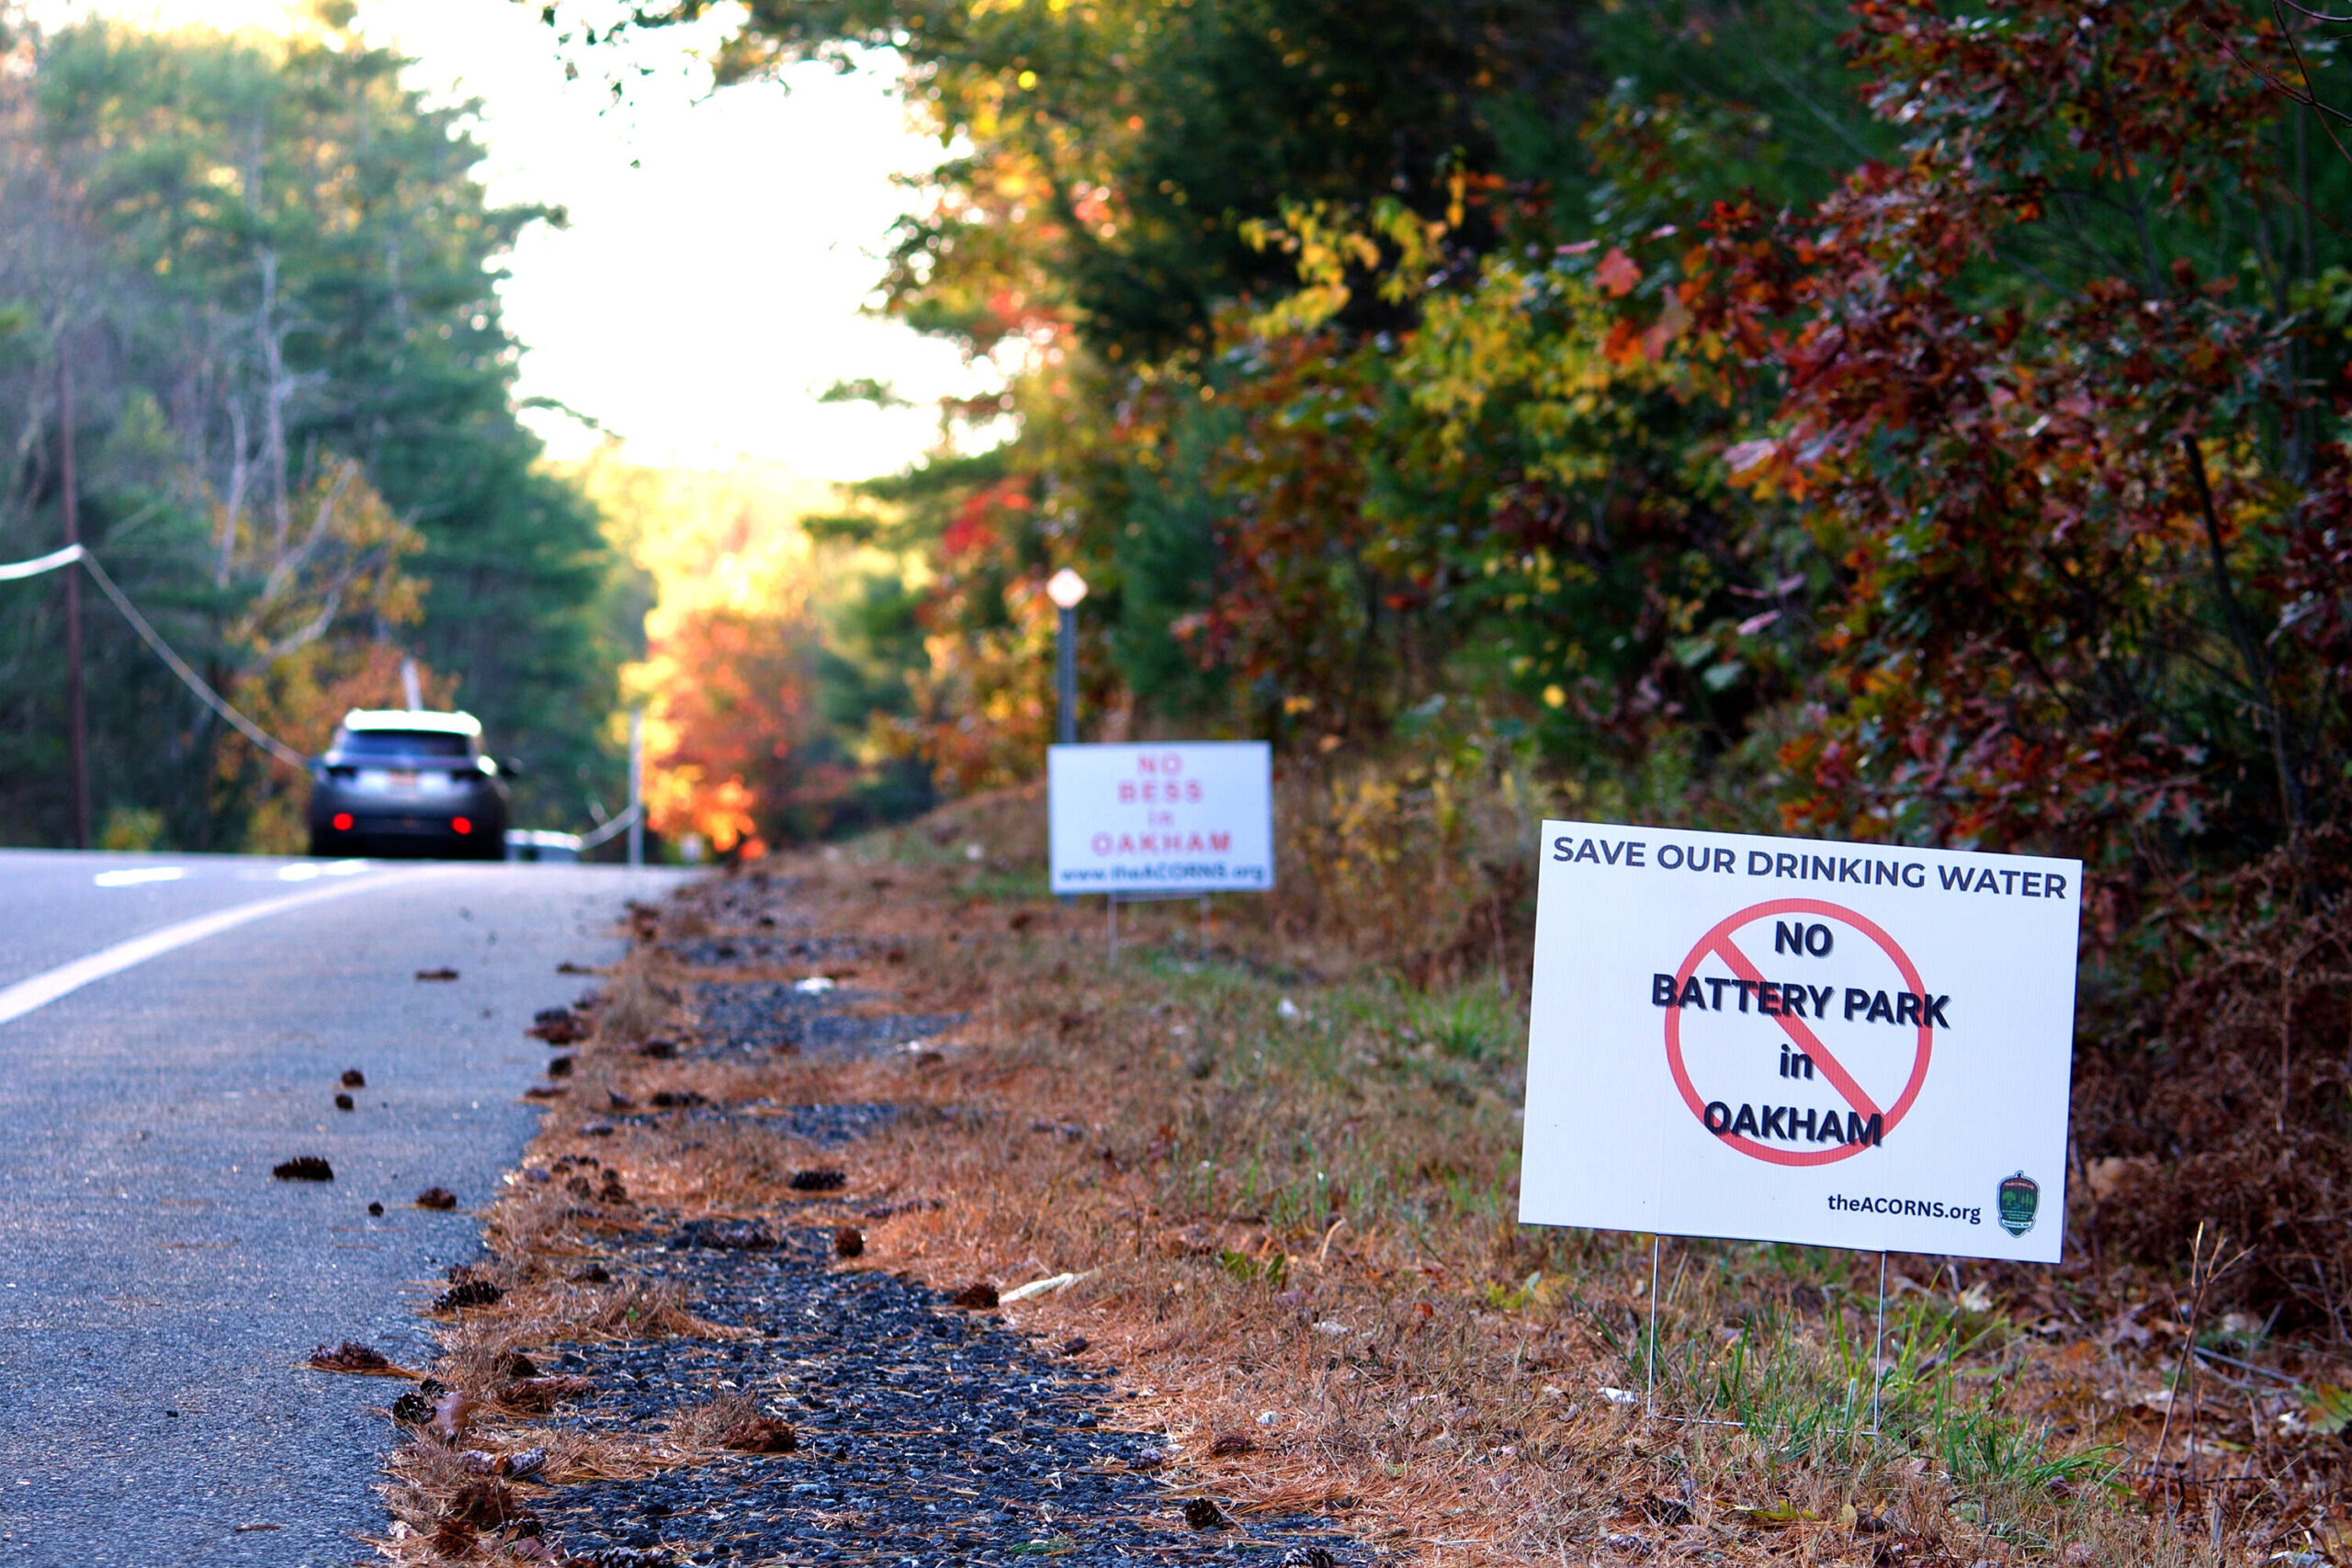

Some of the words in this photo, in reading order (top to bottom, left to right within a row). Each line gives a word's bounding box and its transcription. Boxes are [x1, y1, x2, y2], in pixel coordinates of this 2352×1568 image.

[1138, 753, 1183, 774] NO
[1118, 779, 1203, 805] BESS
[1091, 829, 1231, 857] OAKHAM
[1553, 837, 1646, 868] SAVE
[1657, 842, 1736, 874] OUR
[1747, 850, 1926, 888] DRINKING
[1938, 864, 2067, 899] WATER
[1774, 920, 1834, 957] NO
[1652, 973, 1833, 1021] BATTERY
[1843, 987, 1951, 1029] PARK
[1779, 1043, 1815, 1079] in
[1702, 1100, 1883, 1146] OAKHAM
[1827, 1194, 1982, 1224] theACORNS.org
